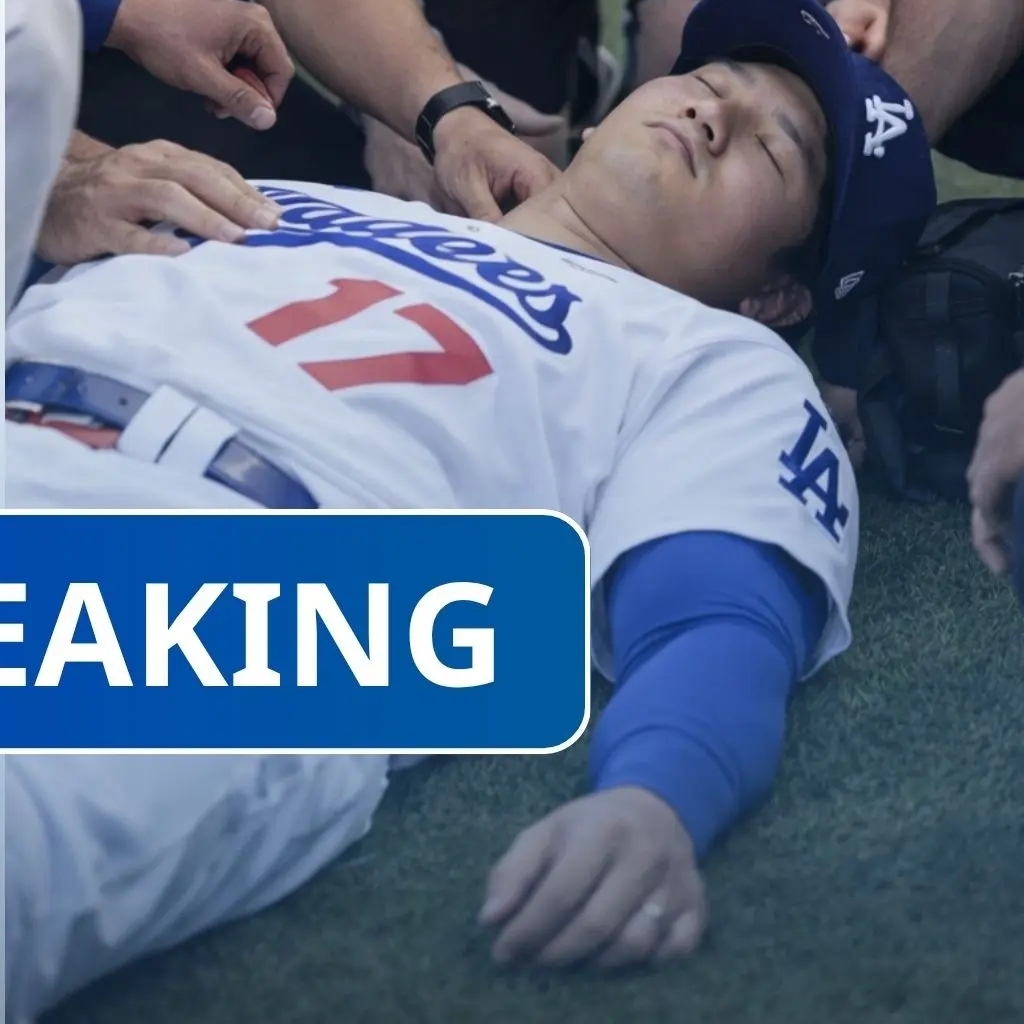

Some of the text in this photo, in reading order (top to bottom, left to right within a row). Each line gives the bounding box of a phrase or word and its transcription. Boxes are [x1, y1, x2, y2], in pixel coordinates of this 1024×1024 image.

[862, 94, 914, 158] LA
[245, 278, 494, 393] 17
[778, 398, 849, 543] LA
